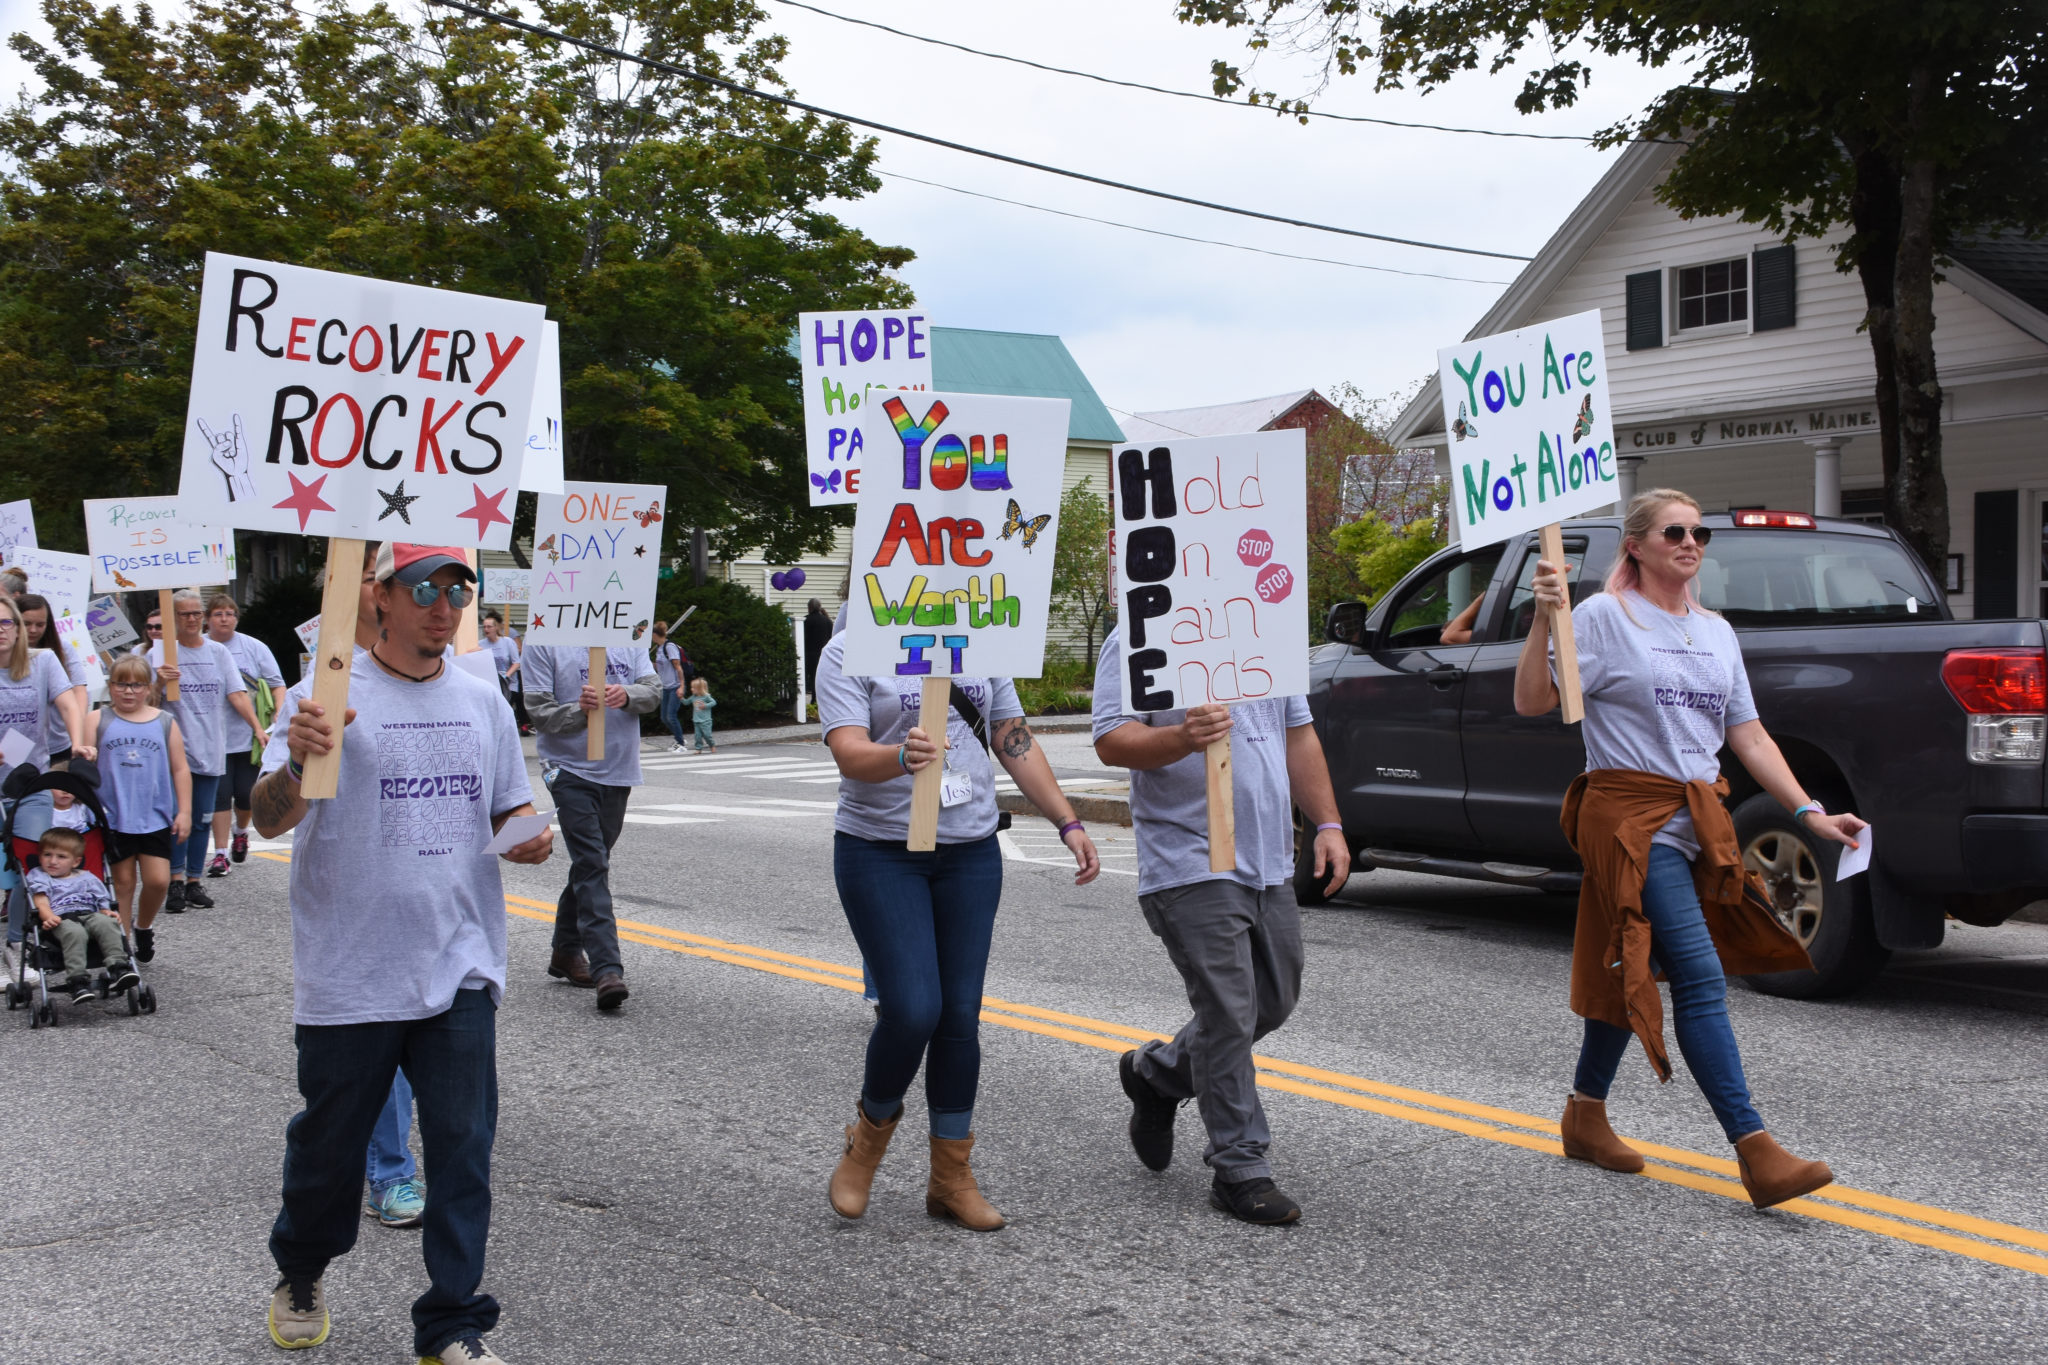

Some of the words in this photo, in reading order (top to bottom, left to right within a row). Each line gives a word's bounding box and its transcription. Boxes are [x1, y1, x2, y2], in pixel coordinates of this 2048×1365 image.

[225, 268, 525, 396] RECOVERY
[815, 316, 926, 366] HOPE
[1542, 332, 1596, 400] Are
[822, 376, 888, 416] Ho
[265, 385, 507, 475] ROCKS
[828, 427, 863, 462] PA
[1633, 431, 1676, 448] CLUB
[1690, 421, 1708, 445] of
[1118, 446, 1265, 521] Hold
[1462, 453, 1527, 526] Not
[1537, 430, 1616, 503] Alone
[107, 504, 178, 528] Recover
[563, 492, 636, 523] ONE
[130, 528, 168, 547] IS
[561, 527, 626, 561] DAY
[871, 503, 993, 567] Are
[1239, 538, 1272, 557] STOP
[1126, 525, 1210, 583] On
[539, 570, 581, 594] AT
[603, 570, 624, 591] A
[1257, 567, 1288, 599] STOP
[548, 601, 633, 629] TIME
[864, 572, 1020, 628] Worth
[1126, 583, 1260, 649] Pain
[895, 634, 968, 675] IT
[1128, 647, 1273, 712] Ends
[899, 685, 985, 712] RERY
[1654, 687, 1727, 716] RECOVERY
[375, 730, 481, 753] RECOVERY
[381, 722, 435, 730] WESTERN
[106, 737, 135, 751] OCEAN
[140, 738, 161, 753] CITY
[380, 775, 482, 802] RECOVERY
[1376, 767, 1421, 779] TUNDRA
[945, 784, 971, 804] Jess
[418, 847, 453, 857] RALLY
